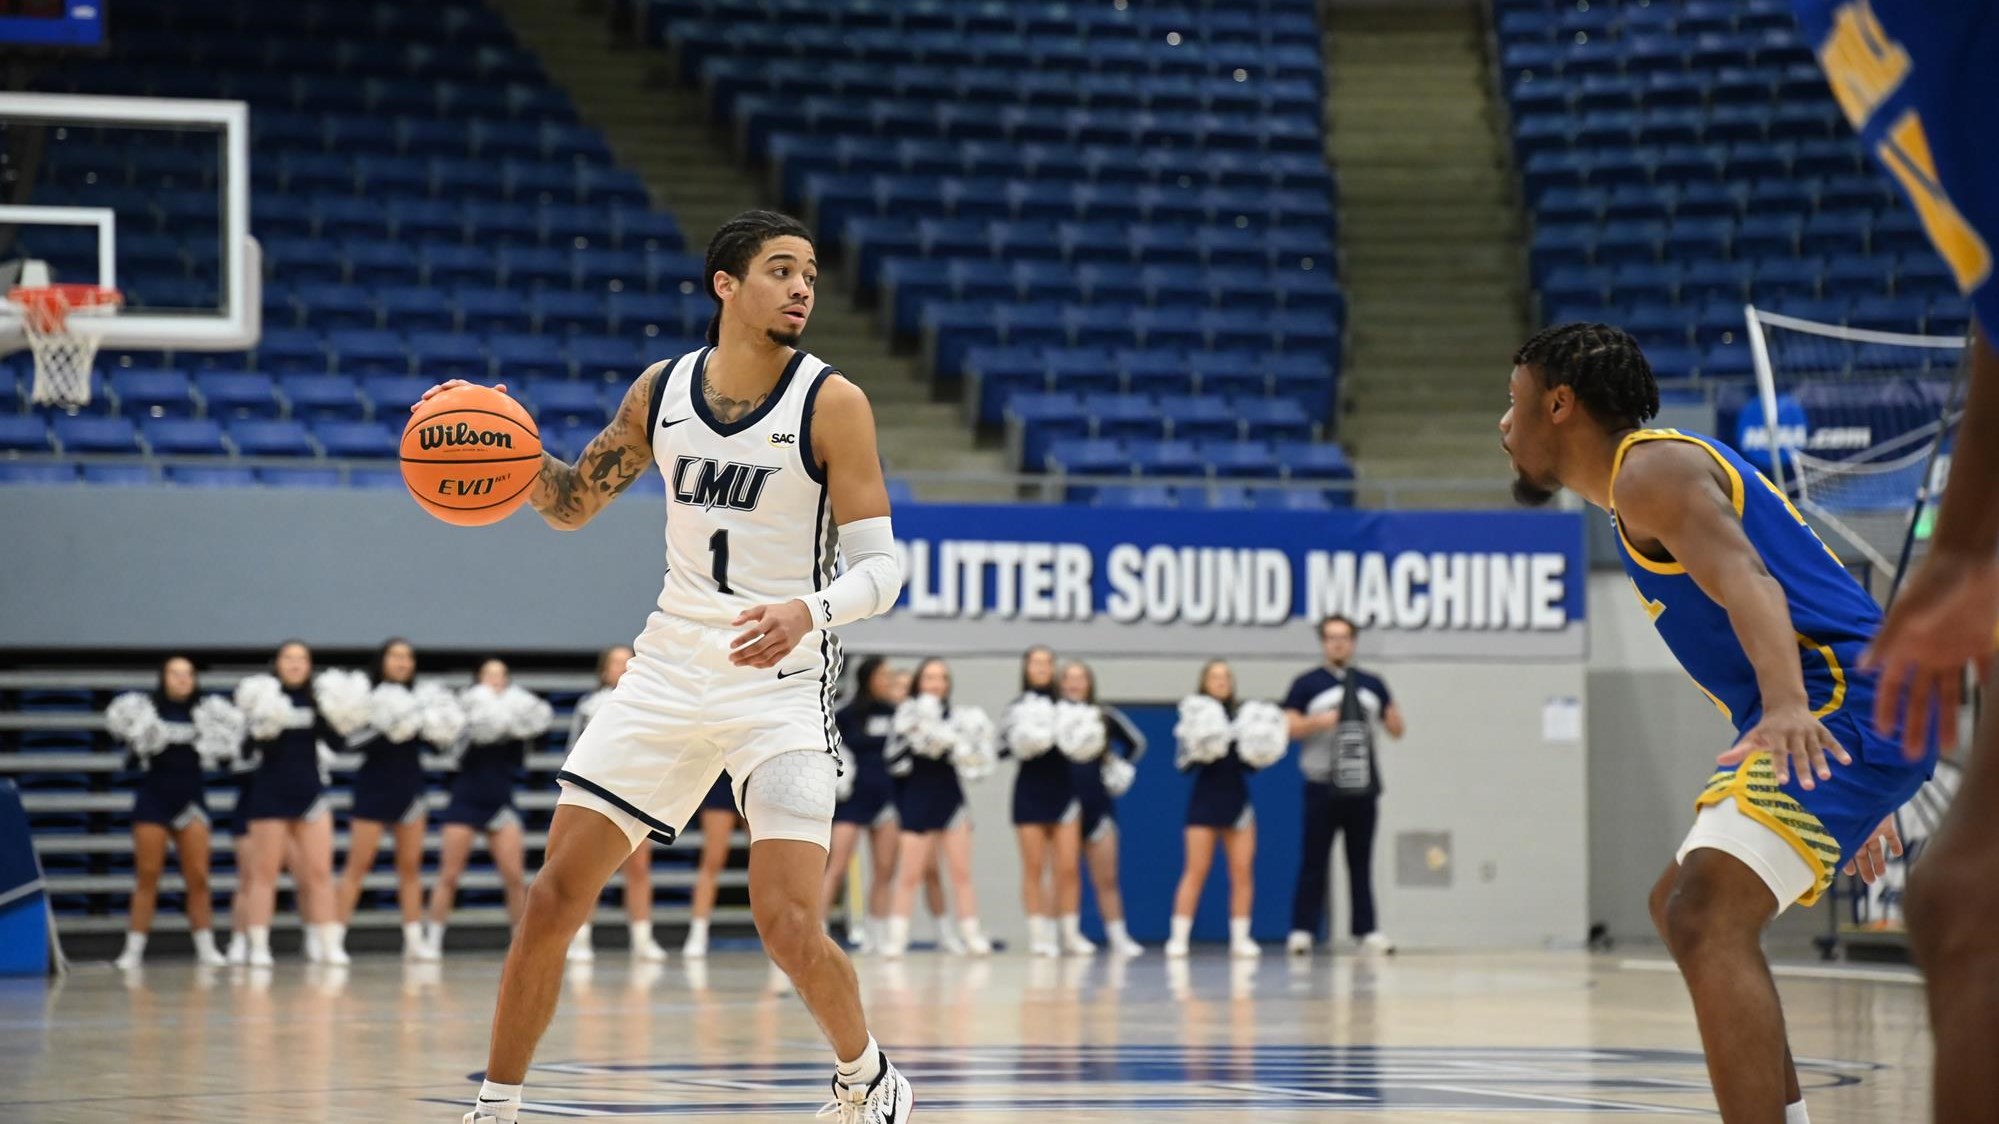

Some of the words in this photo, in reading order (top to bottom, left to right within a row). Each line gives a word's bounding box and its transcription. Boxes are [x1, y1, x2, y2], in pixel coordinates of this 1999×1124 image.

[419, 422, 512, 450] Wilson
[771, 433, 795, 444] SAC
[438, 478, 494, 496] EVO
[709, 528, 734, 595] 1
[1106, 543, 1292, 626] SOUND
[1305, 550, 1567, 630] MACHINE
